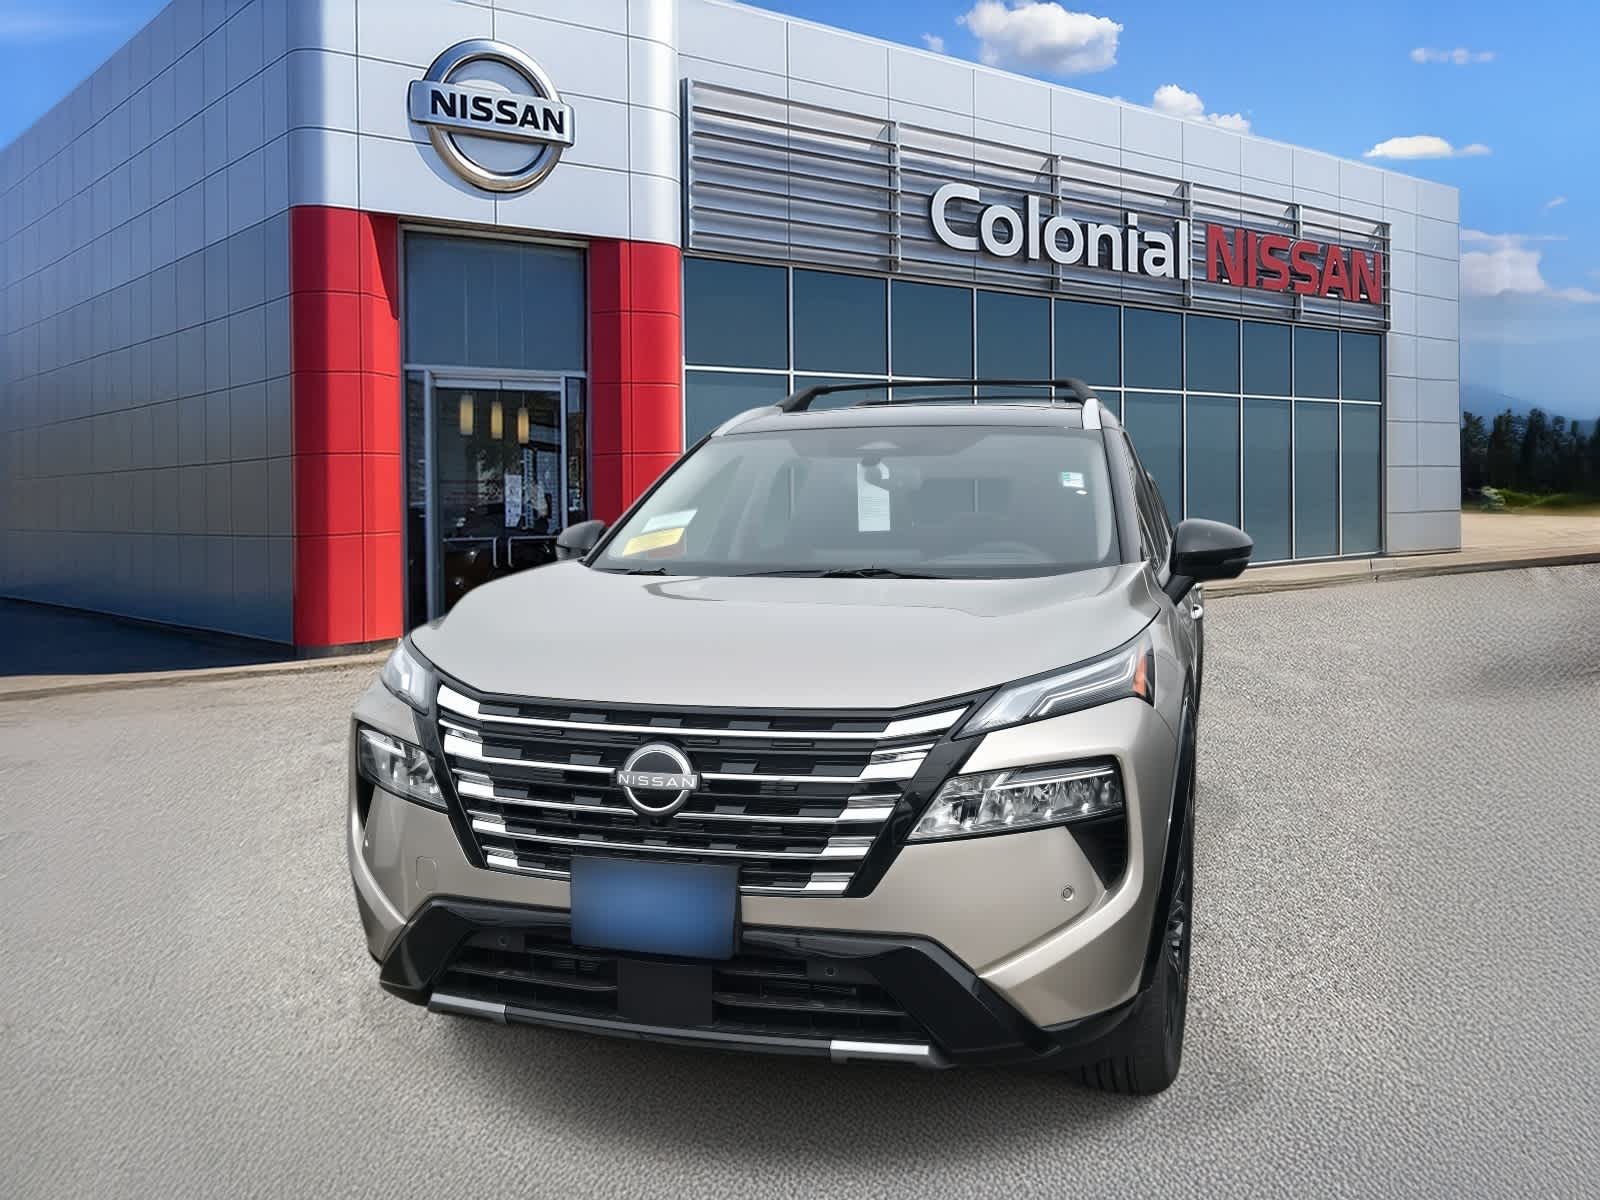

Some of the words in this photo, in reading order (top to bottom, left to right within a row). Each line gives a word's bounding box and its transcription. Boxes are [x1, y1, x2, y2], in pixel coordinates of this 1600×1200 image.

[431, 89, 564, 134] NISSAN
[930, 183, 1188, 280] Colonial
[1206, 223, 1383, 305] NISSAN
[618, 774, 696, 788] NISSAN
